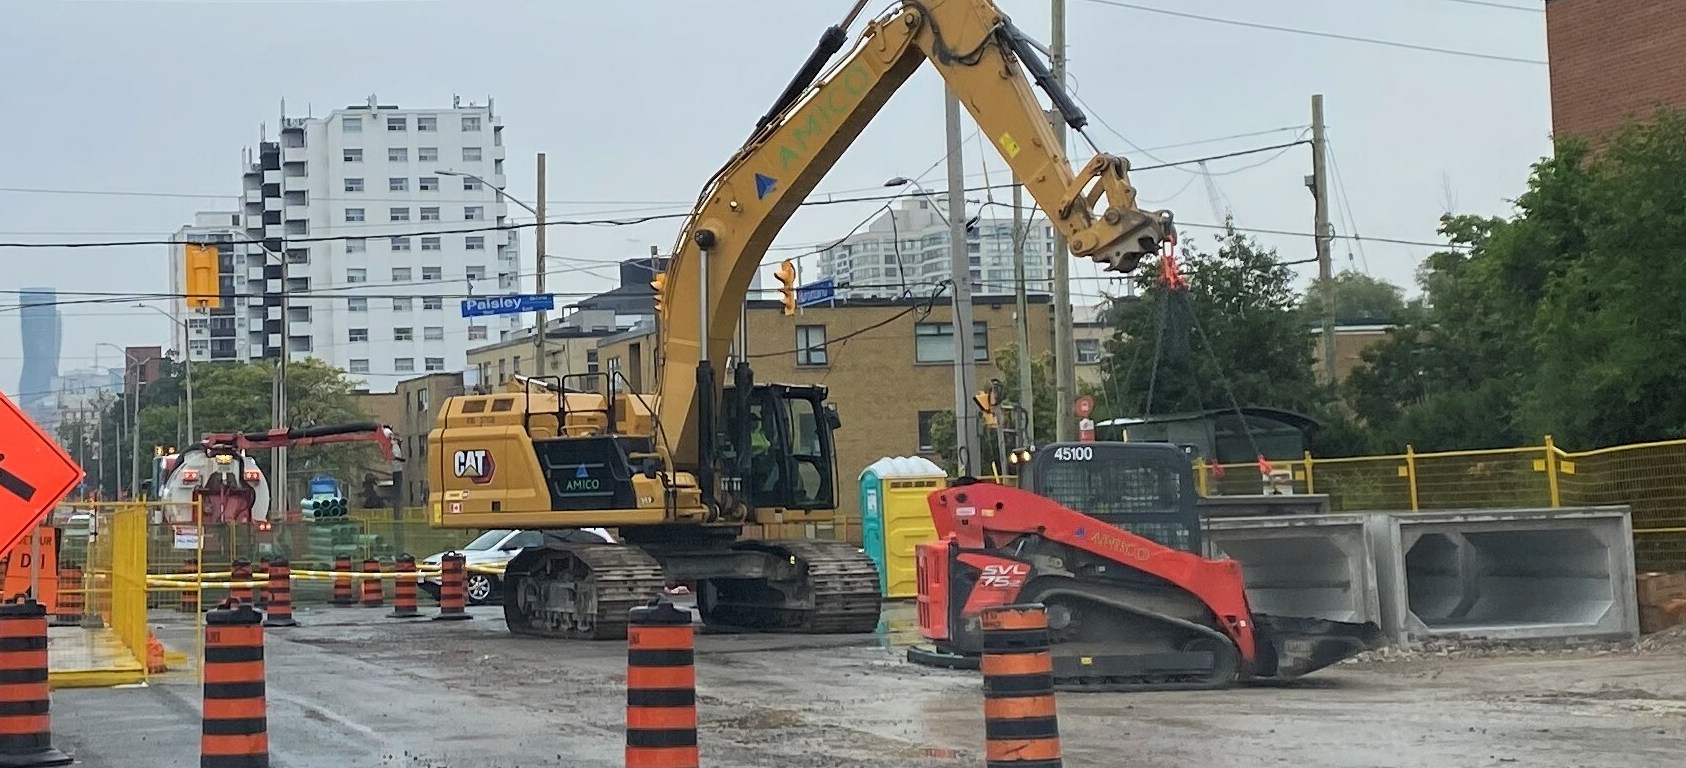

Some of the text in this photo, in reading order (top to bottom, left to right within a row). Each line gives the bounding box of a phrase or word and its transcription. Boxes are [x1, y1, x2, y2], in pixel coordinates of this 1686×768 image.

[779, 65, 868, 172] AMICO
[466, 298, 521, 311] Paisley
[1054, 446, 1093, 461] 45100
[455, 450, 486, 477] CAT
[566, 479, 600, 490] AMICO
[982, 564, 1027, 575] SVL
